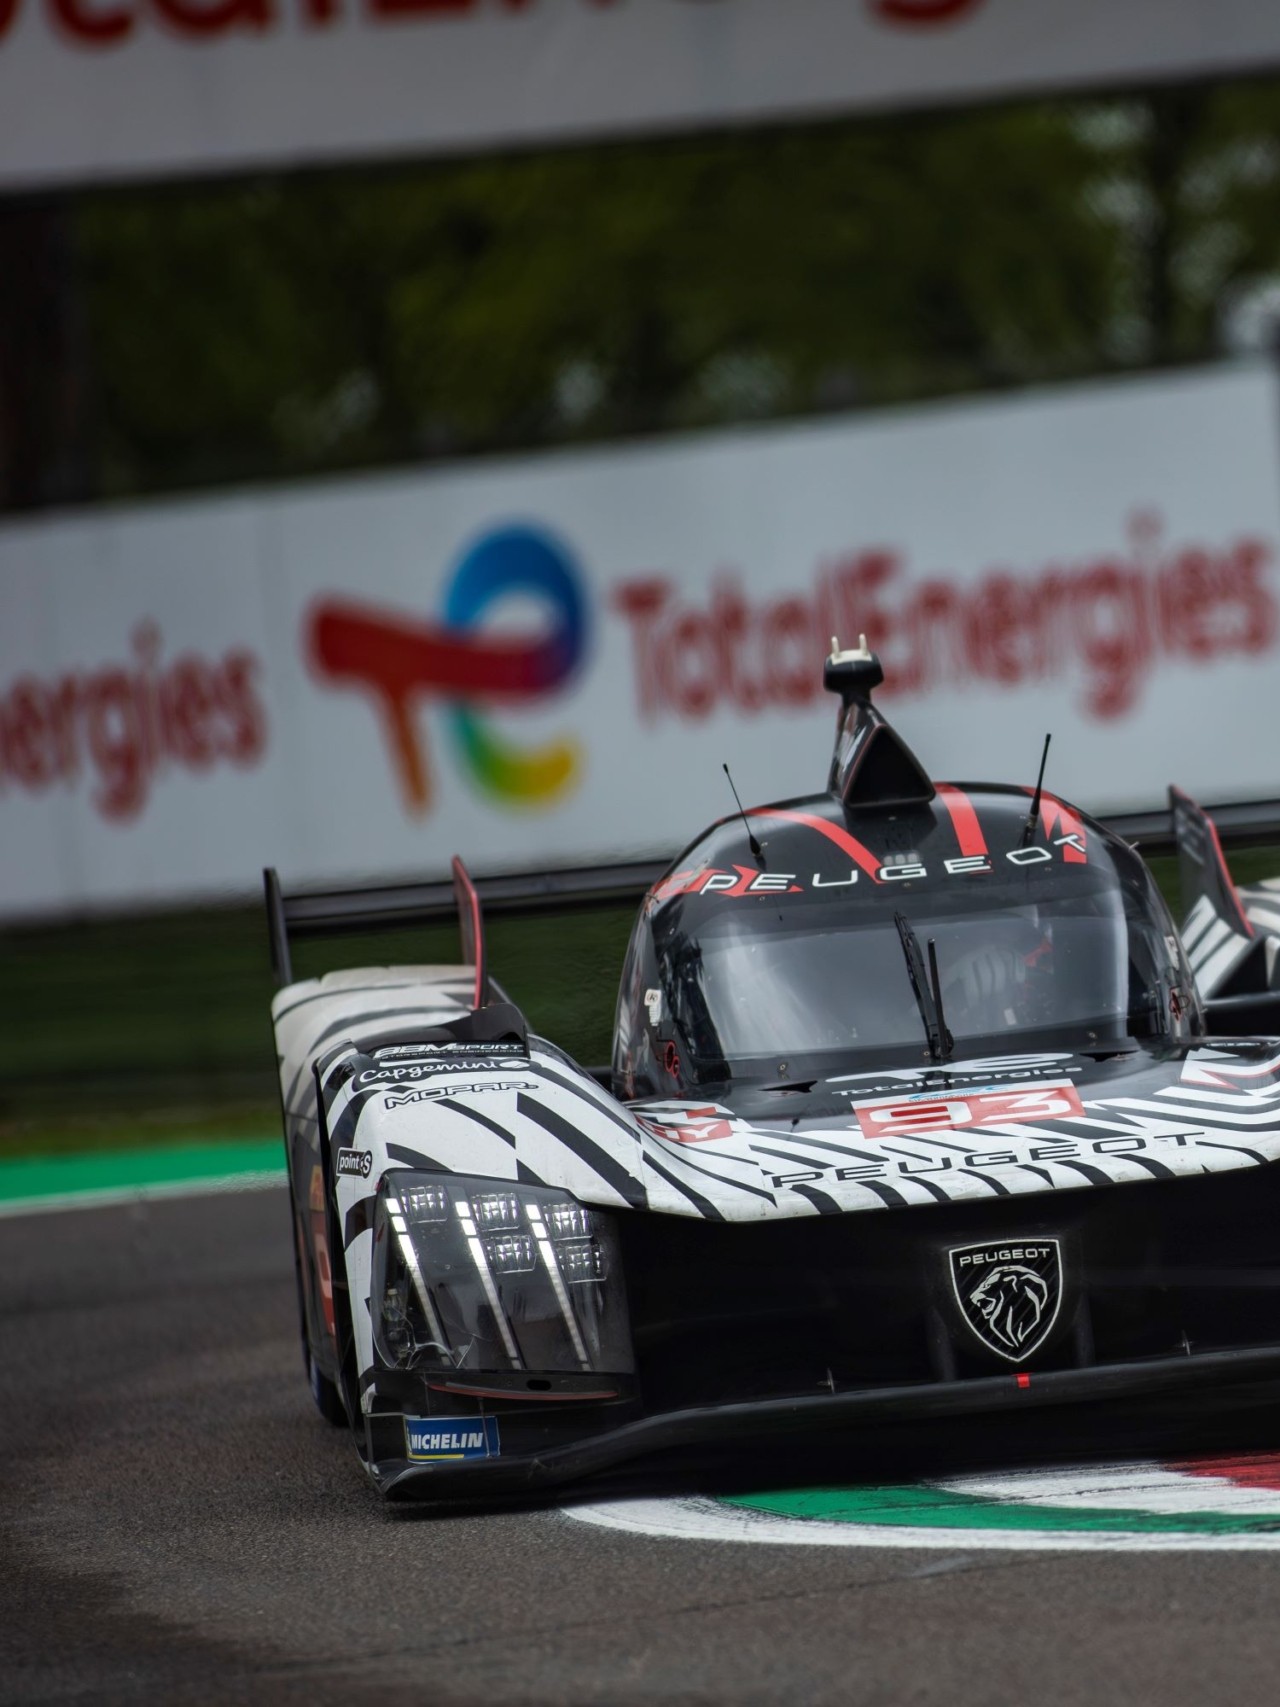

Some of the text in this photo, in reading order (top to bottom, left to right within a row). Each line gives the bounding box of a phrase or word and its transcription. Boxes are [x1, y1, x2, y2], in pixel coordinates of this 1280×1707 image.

[0, 616, 269, 828] ergies
[700, 834, 1087, 896] PEUGEOT
[359, 1060, 496, 1083] Capgemini
[831, 1067, 1083, 1096] TotalEnergies
[384, 1081, 532, 1110] MOPAR
[869, 1090, 1072, 1133] 93
[339, 1154, 360, 1171] point
[770, 1131, 1206, 1188] PEUGEOT
[959, 1248, 1050, 1267] PEUGEOT
[410, 1432, 484, 1450] MICHELIN
